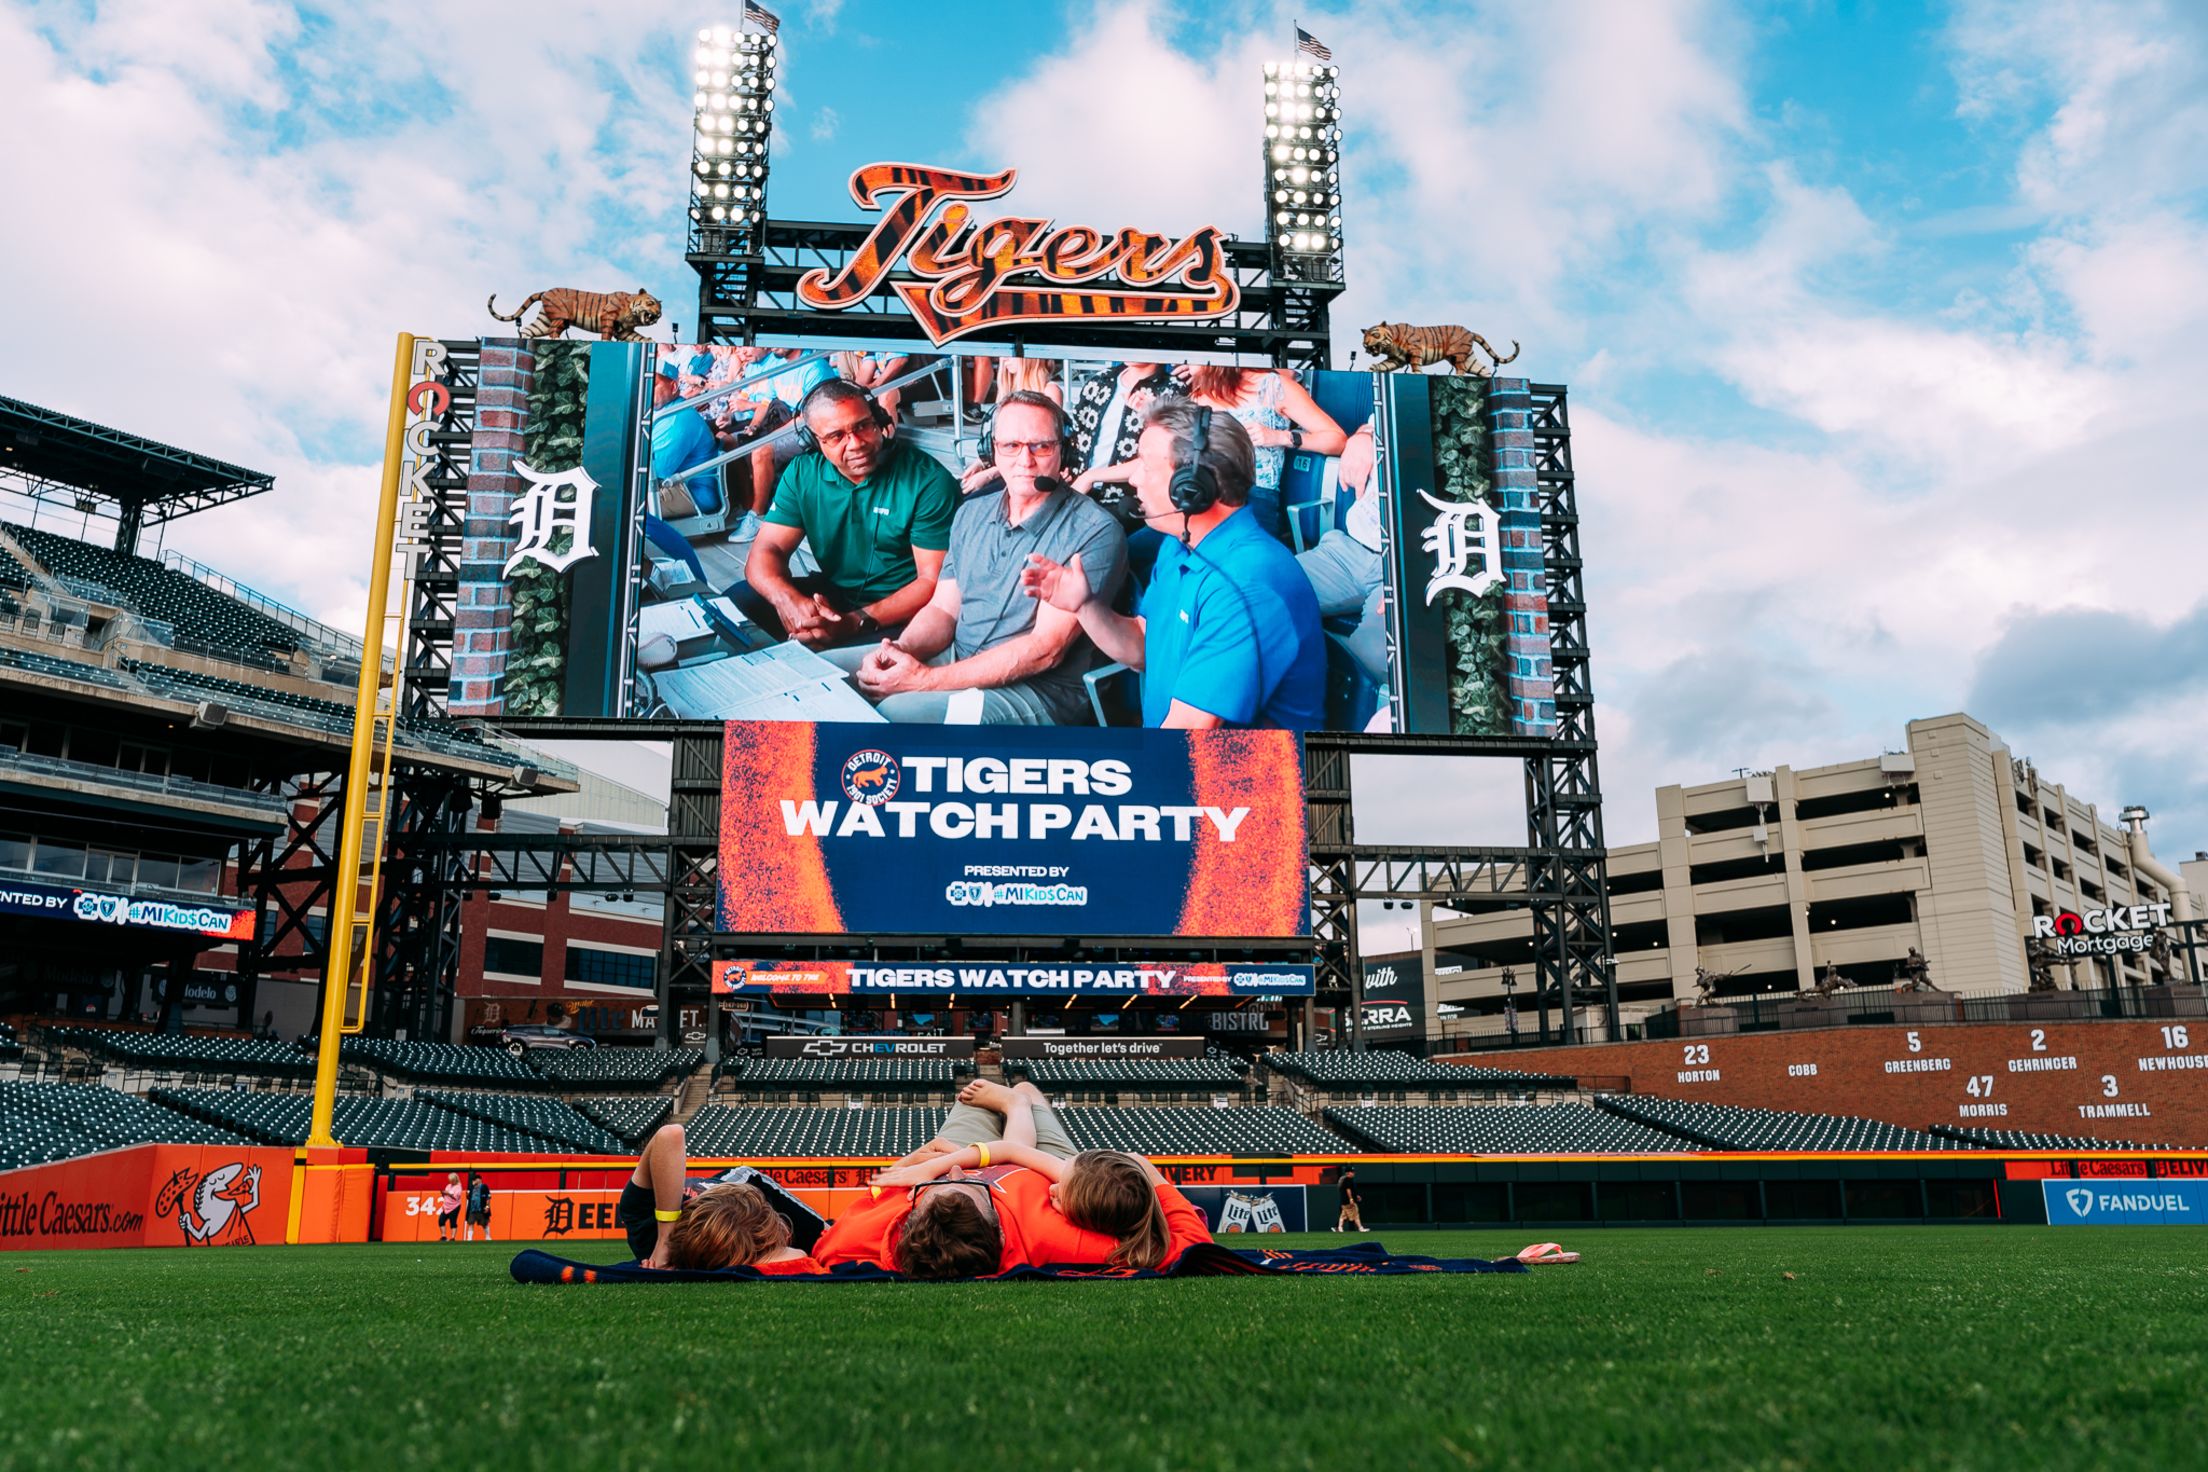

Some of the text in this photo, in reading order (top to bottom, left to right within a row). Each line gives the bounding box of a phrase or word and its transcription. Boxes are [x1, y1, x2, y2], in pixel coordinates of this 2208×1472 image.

[797, 162, 1241, 348] Tigers
[395, 340, 451, 580] ROCKET
[502, 460, 602, 580] D
[1416, 488, 1507, 607] D
[847, 752, 892, 771] DETROIT
[902, 756, 1132, 796] TIGERS
[866, 778, 897, 805] SOCIETY
[779, 800, 1251, 842] WATCH PARTY
[964, 865, 1070, 877] PRESENTED BY
[45, 896, 68, 909] BY
[2032, 903, 2172, 939] ROCKET
[2056, 934, 2154, 954] Mortgage
[845, 968, 1177, 989] TIGERS WATCH PARTY
[185, 983, 217, 1000] odelo
[1907, 1031, 1921, 1052] 5
[2030, 1029, 2047, 1051] 2
[2160, 1025, 2189, 1049] 16
[851, 1043, 947, 1053] CHEVROLET
[1043, 1042, 1100, 1055] Together
[1101, 1042, 1127, 1054] let's
[1683, 1044, 1710, 1065] 23
[1788, 1063, 1817, 1076] COBB
[1884, 1058, 1951, 1073] GREENBERG
[2008, 1056, 2077, 1073] GEHRINGER
[1677, 1069, 1720, 1083] HORTON
[1966, 1075, 1994, 1097] 47
[2101, 1074, 2119, 1098] 3
[1958, 1103, 2008, 1117] MORRIS
[2078, 1103, 2151, 1118] TRAMMELL
[2090, 1160, 2145, 1176] Caesars
[1227, 1204, 1250, 1220] Lite
[2099, 1194, 2190, 1212] FANDUEL
[1257, 1205, 1279, 1225] Lite
